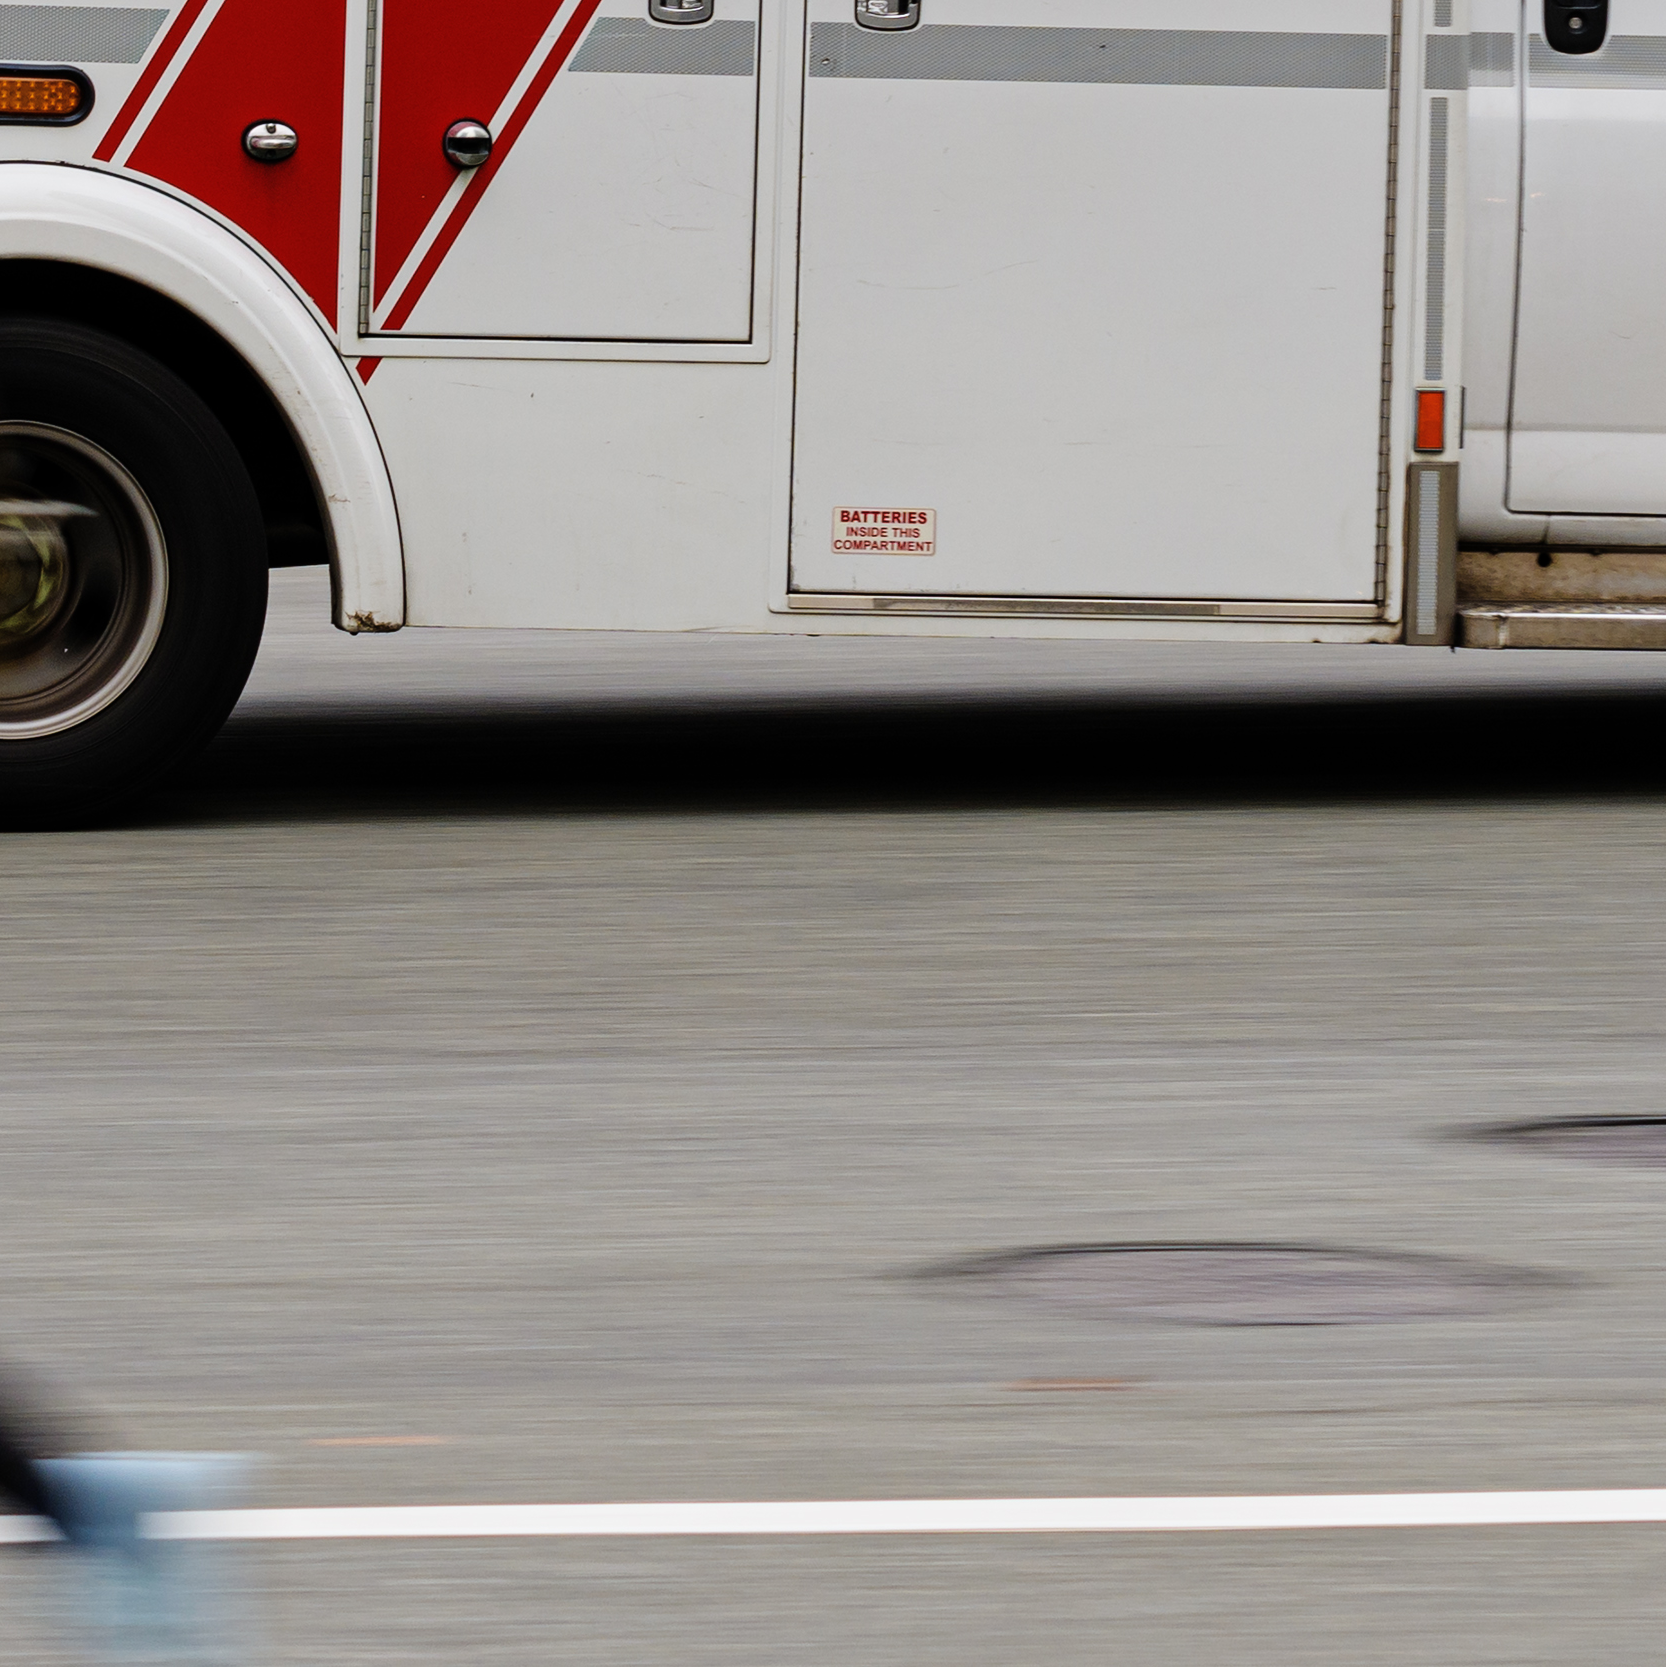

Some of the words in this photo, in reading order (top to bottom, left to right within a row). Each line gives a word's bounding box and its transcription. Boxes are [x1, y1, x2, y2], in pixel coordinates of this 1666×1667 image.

[840, 510, 927, 524] BATTERIES
[845, 526, 889, 538] INSIDE
[891, 527, 921, 539] THIS
[834, 540, 933, 552] COMPARTMENT
